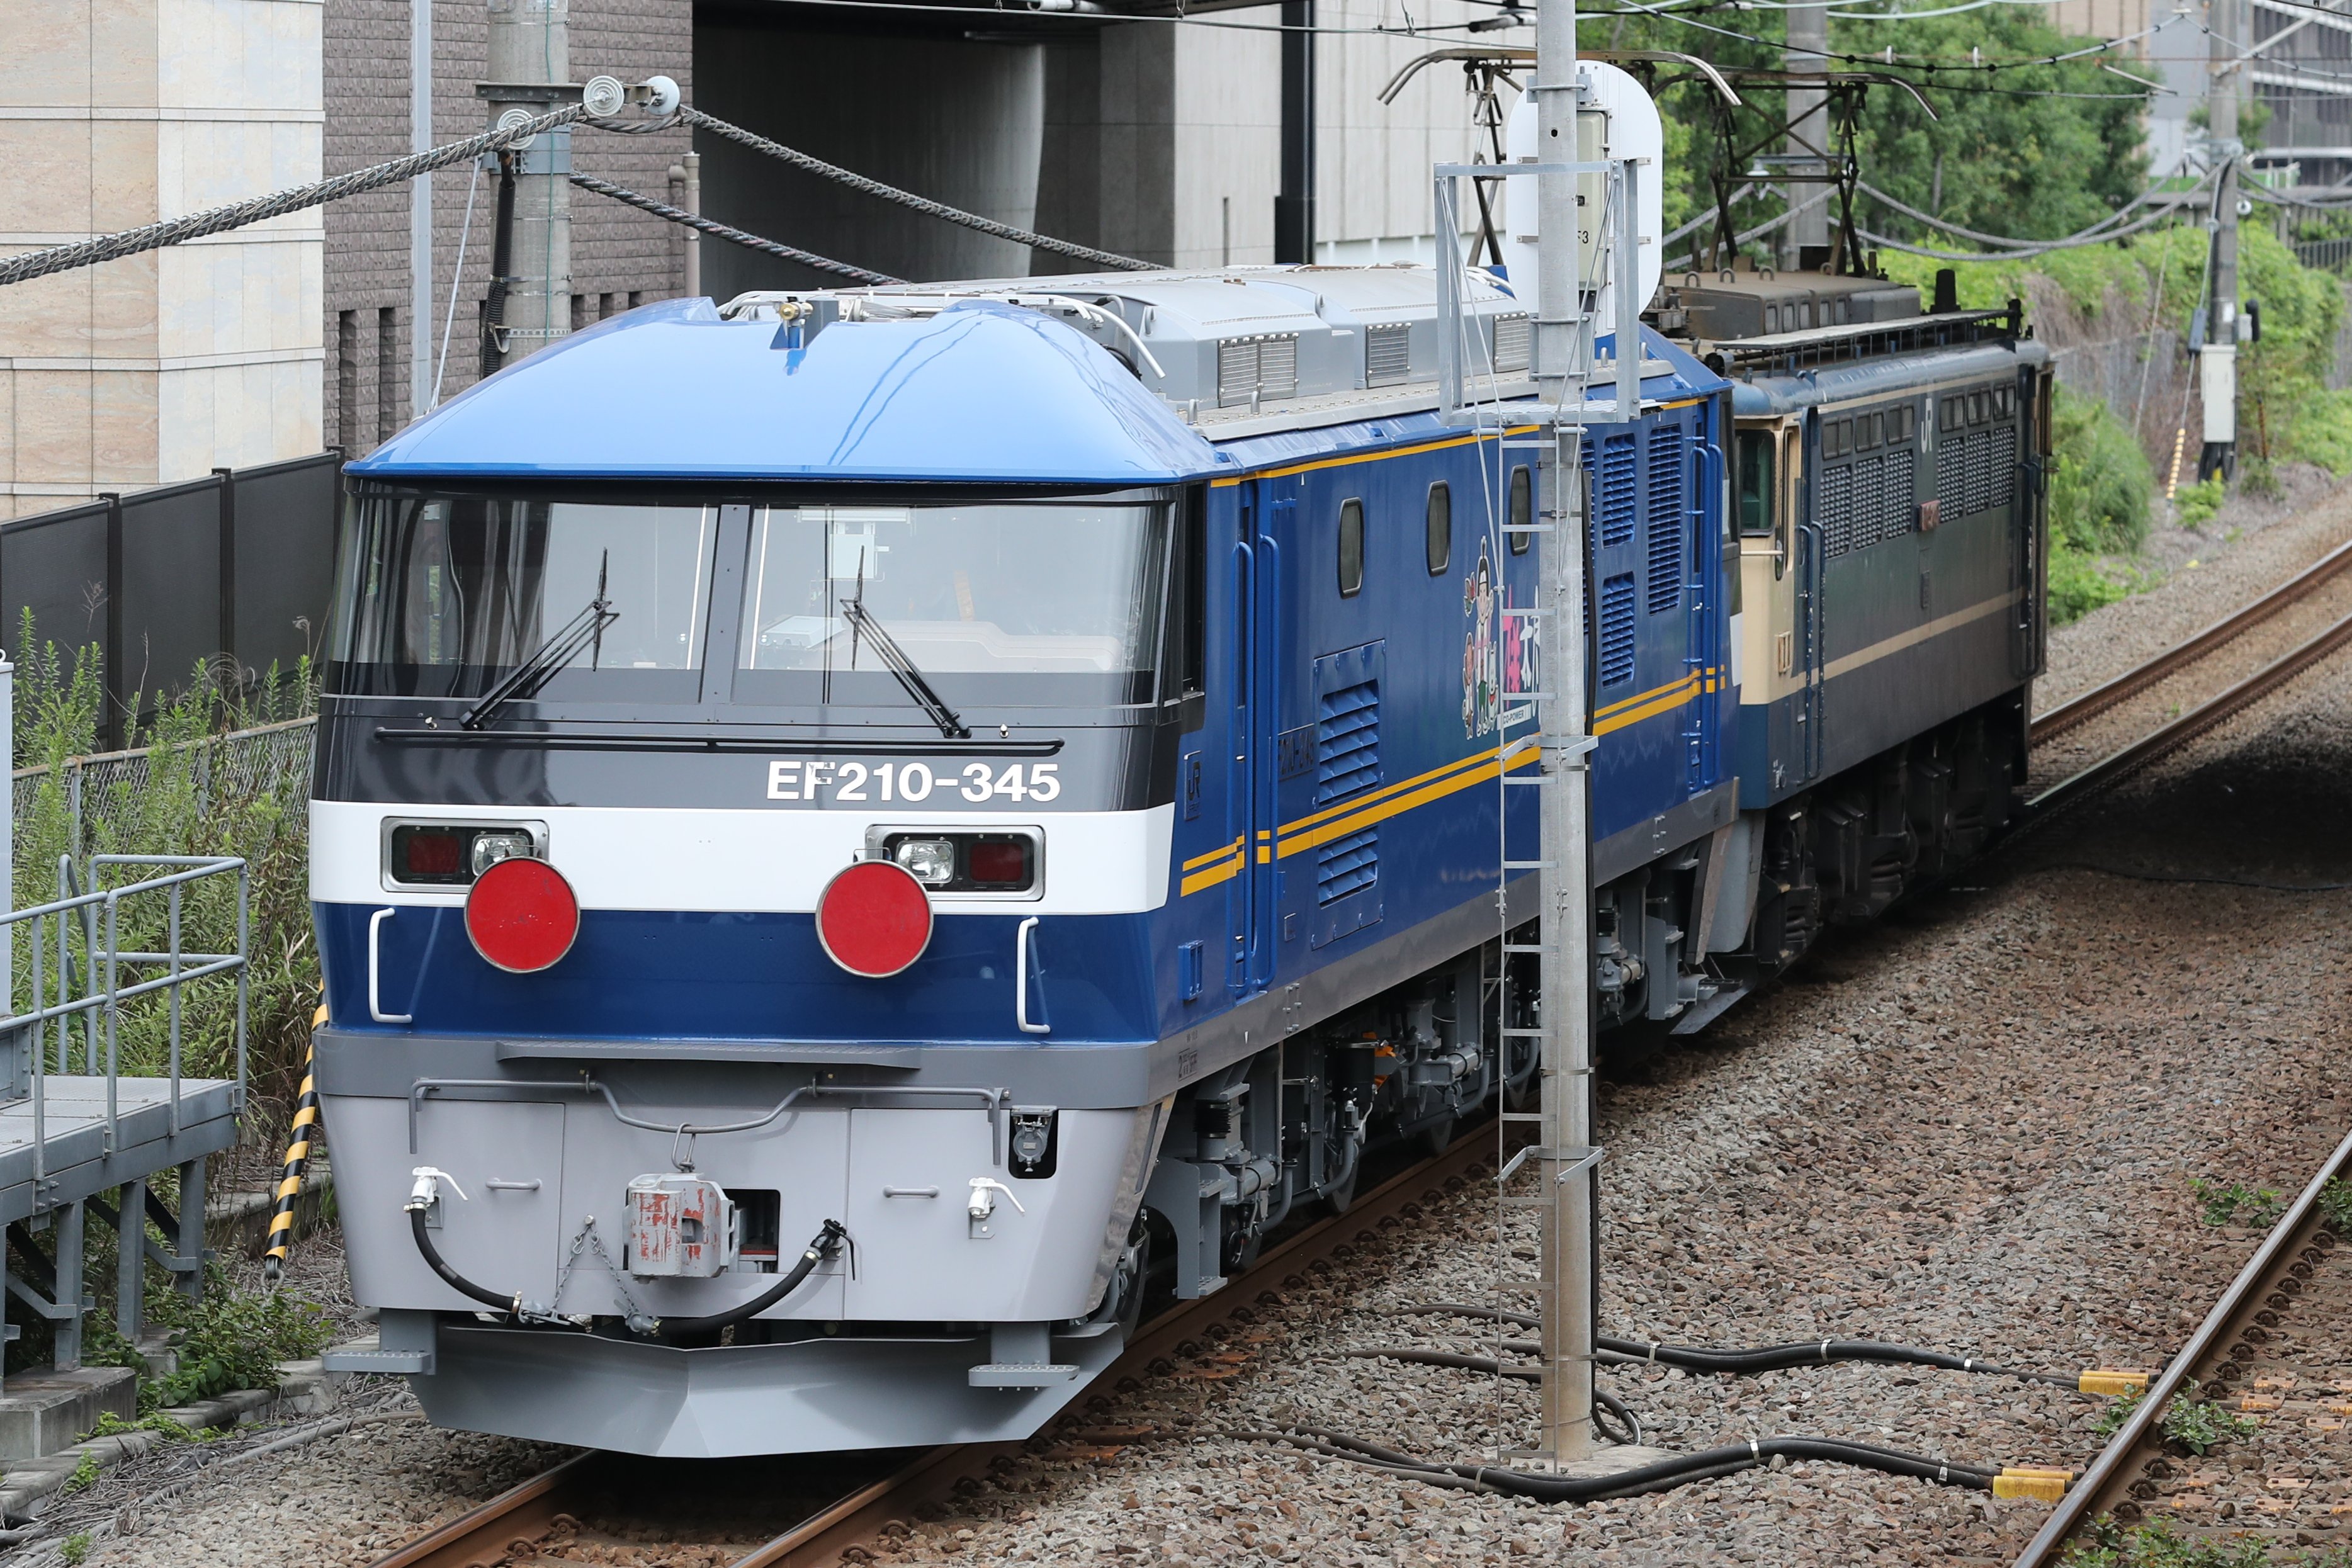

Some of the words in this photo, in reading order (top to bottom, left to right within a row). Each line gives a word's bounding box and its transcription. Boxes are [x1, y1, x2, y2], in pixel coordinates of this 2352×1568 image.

[1921, 397, 1932, 453] JR
[1503, 709, 1525, 725] CO-POWER
[767, 761, 1061, 802] EF210-345
[1188, 760, 1201, 800] JR
